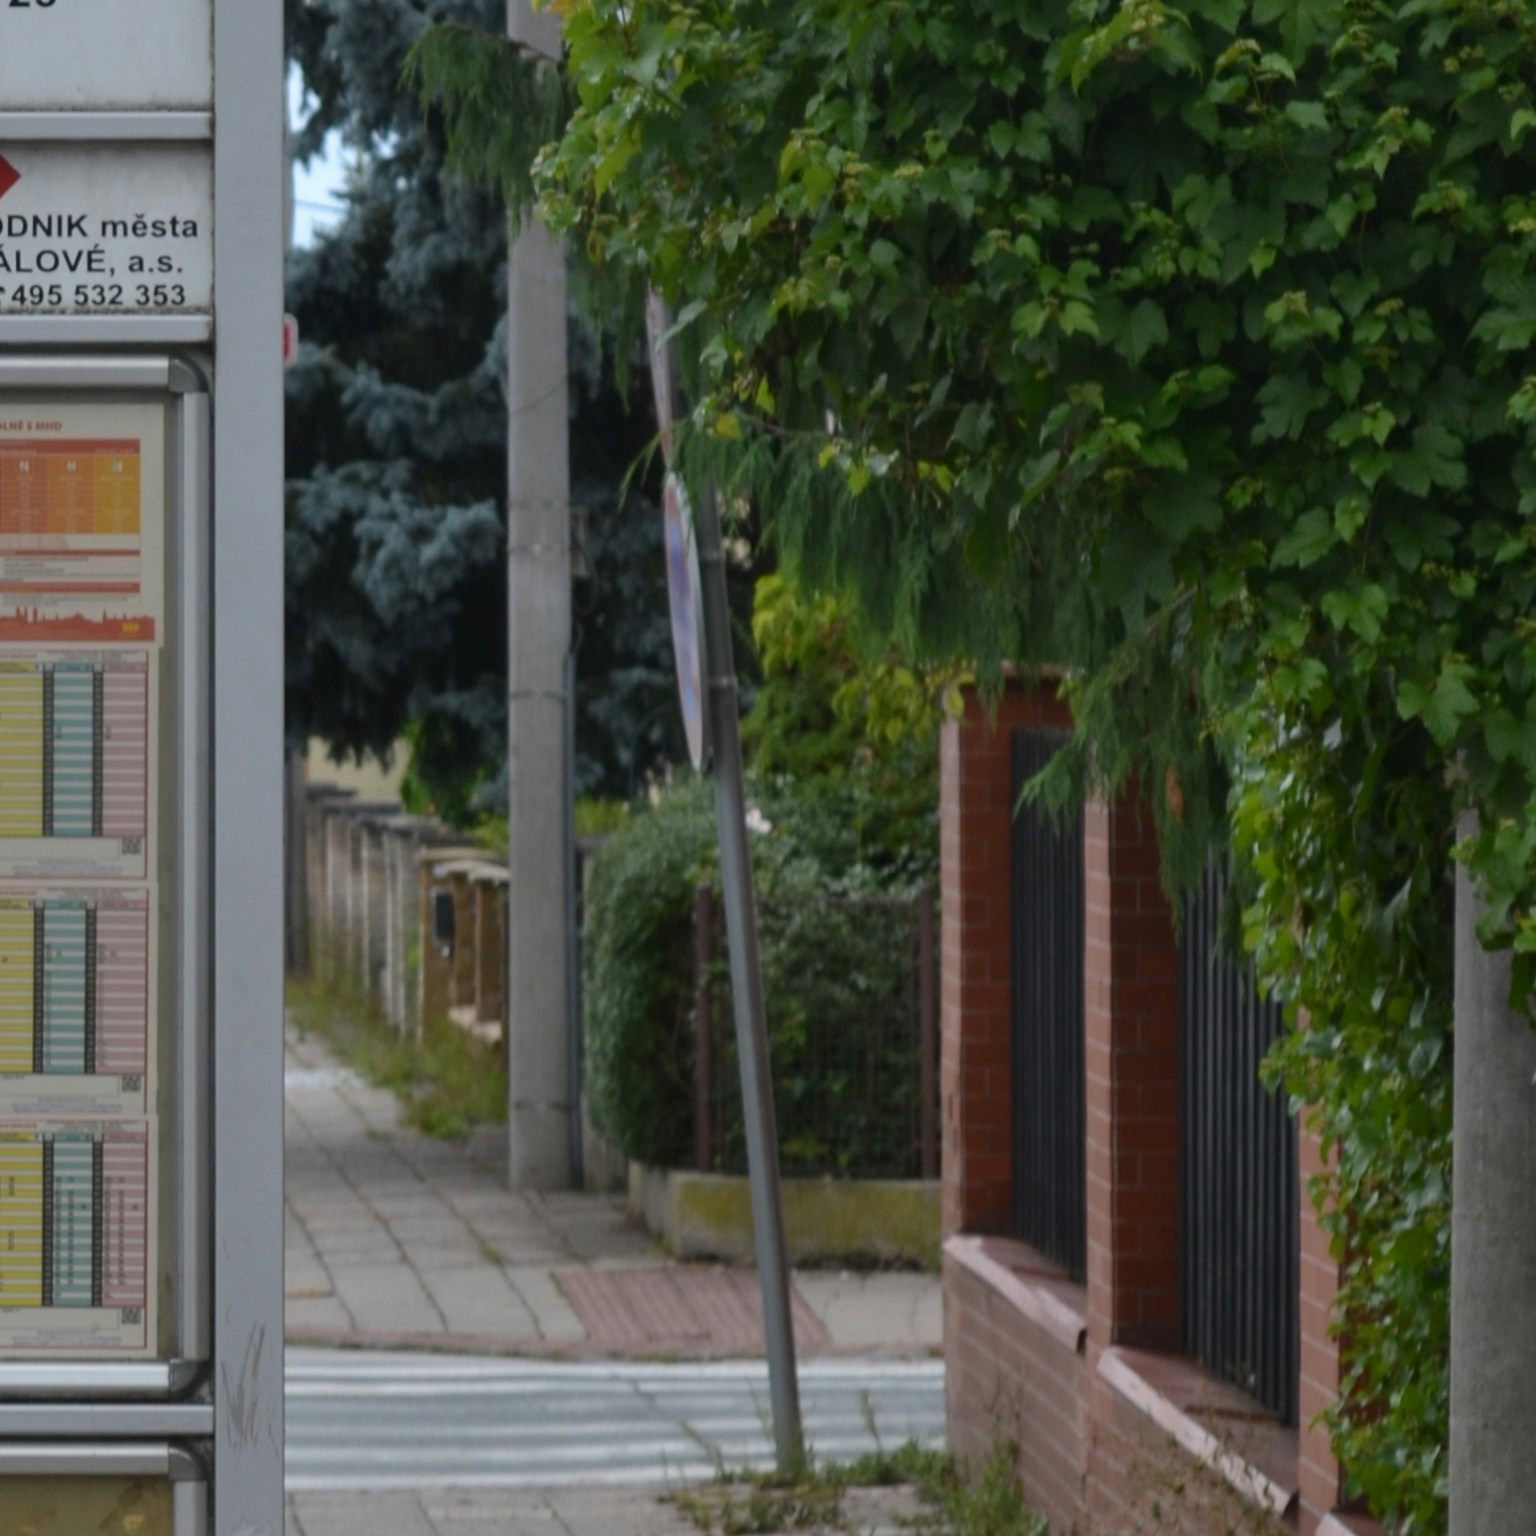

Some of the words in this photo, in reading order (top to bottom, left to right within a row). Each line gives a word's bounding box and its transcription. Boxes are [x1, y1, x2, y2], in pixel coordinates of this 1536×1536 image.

[99, 212, 200, 239] města
[128, 252, 184, 274] a.s.
[10, 284, 63, 307] 495
[73, 284, 124, 307] 532
[135, 284, 186, 307] 353
[35, 421, 63, 432] MHD
